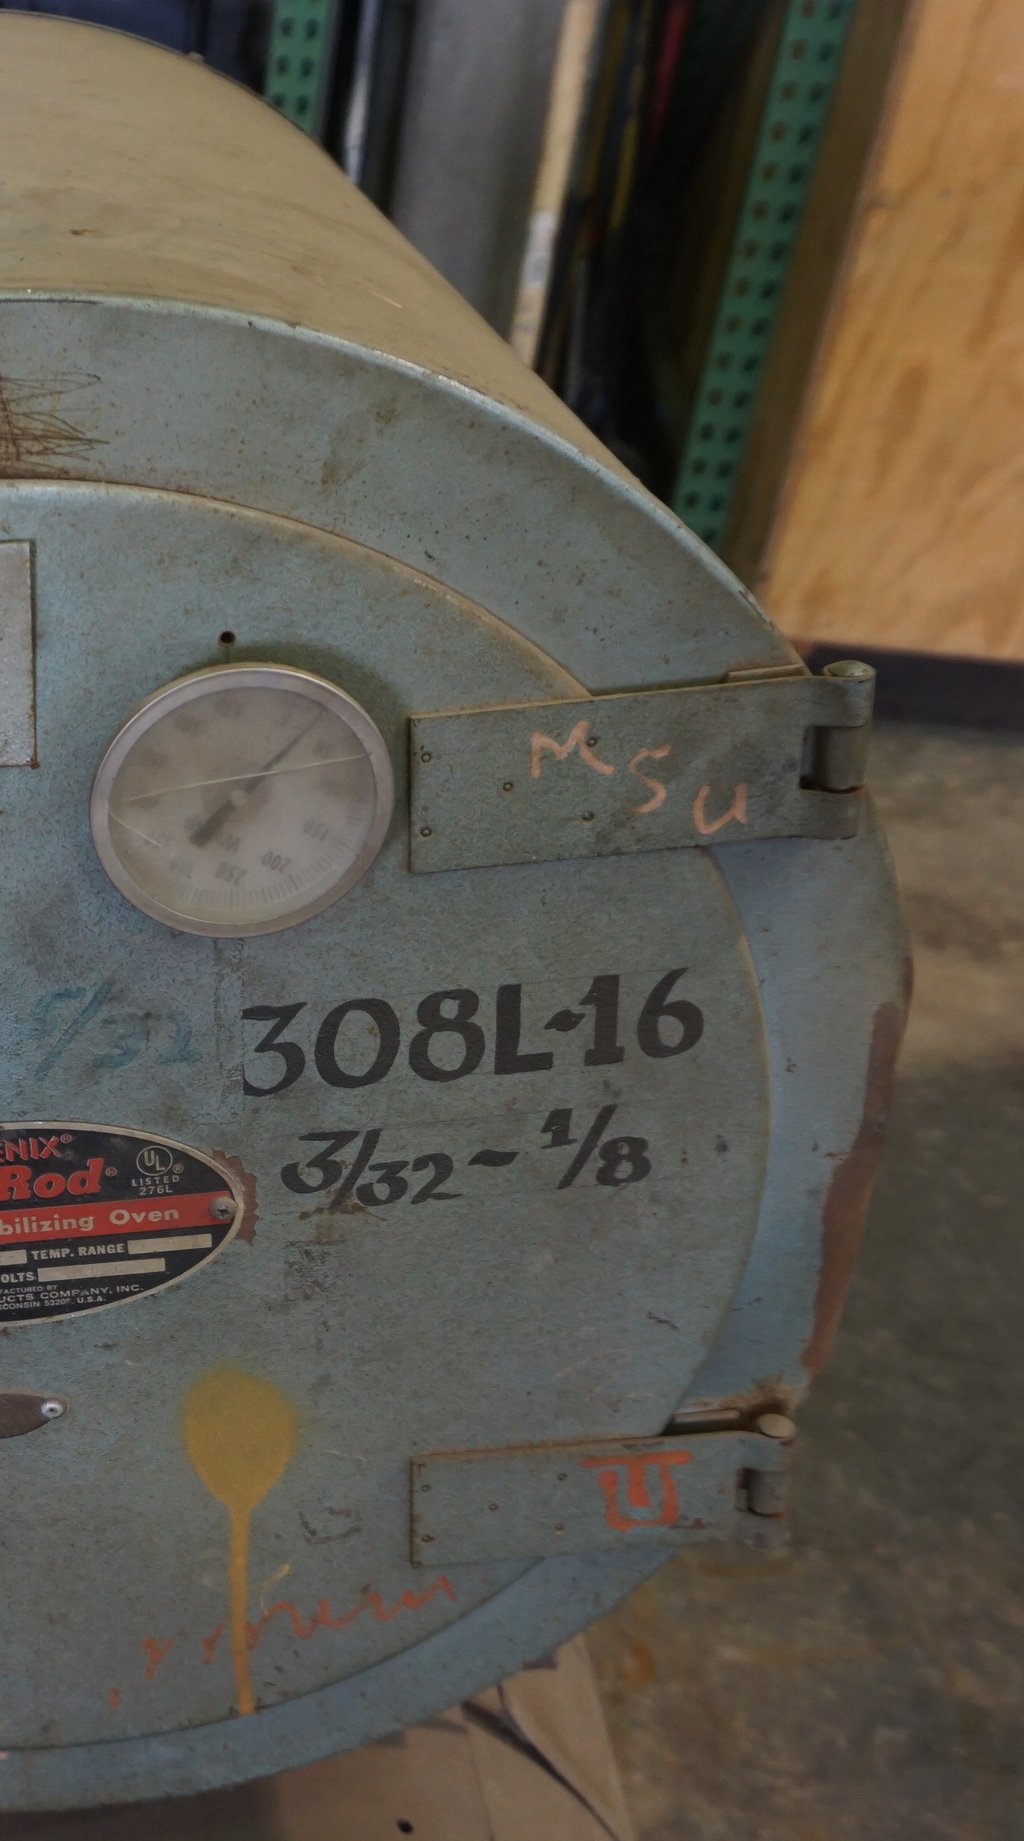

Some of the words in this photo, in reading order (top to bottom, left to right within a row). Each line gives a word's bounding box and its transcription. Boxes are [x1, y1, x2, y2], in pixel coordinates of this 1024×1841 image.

[241, 966, 706, 1098] 308L-16
[280, 1126, 464, 1212] 3/32
[540, 1103, 652, 1191] 1/8
[131, 1174, 181, 1188] LISTED
[108, 1206, 180, 1226] Oven
[31, 1247, 75, 1261] TEMP.
[78, 1243, 125, 1257] RANGE
[46, 1284, 58, 1292] BY
[116, 1284, 144, 1293] INC.
